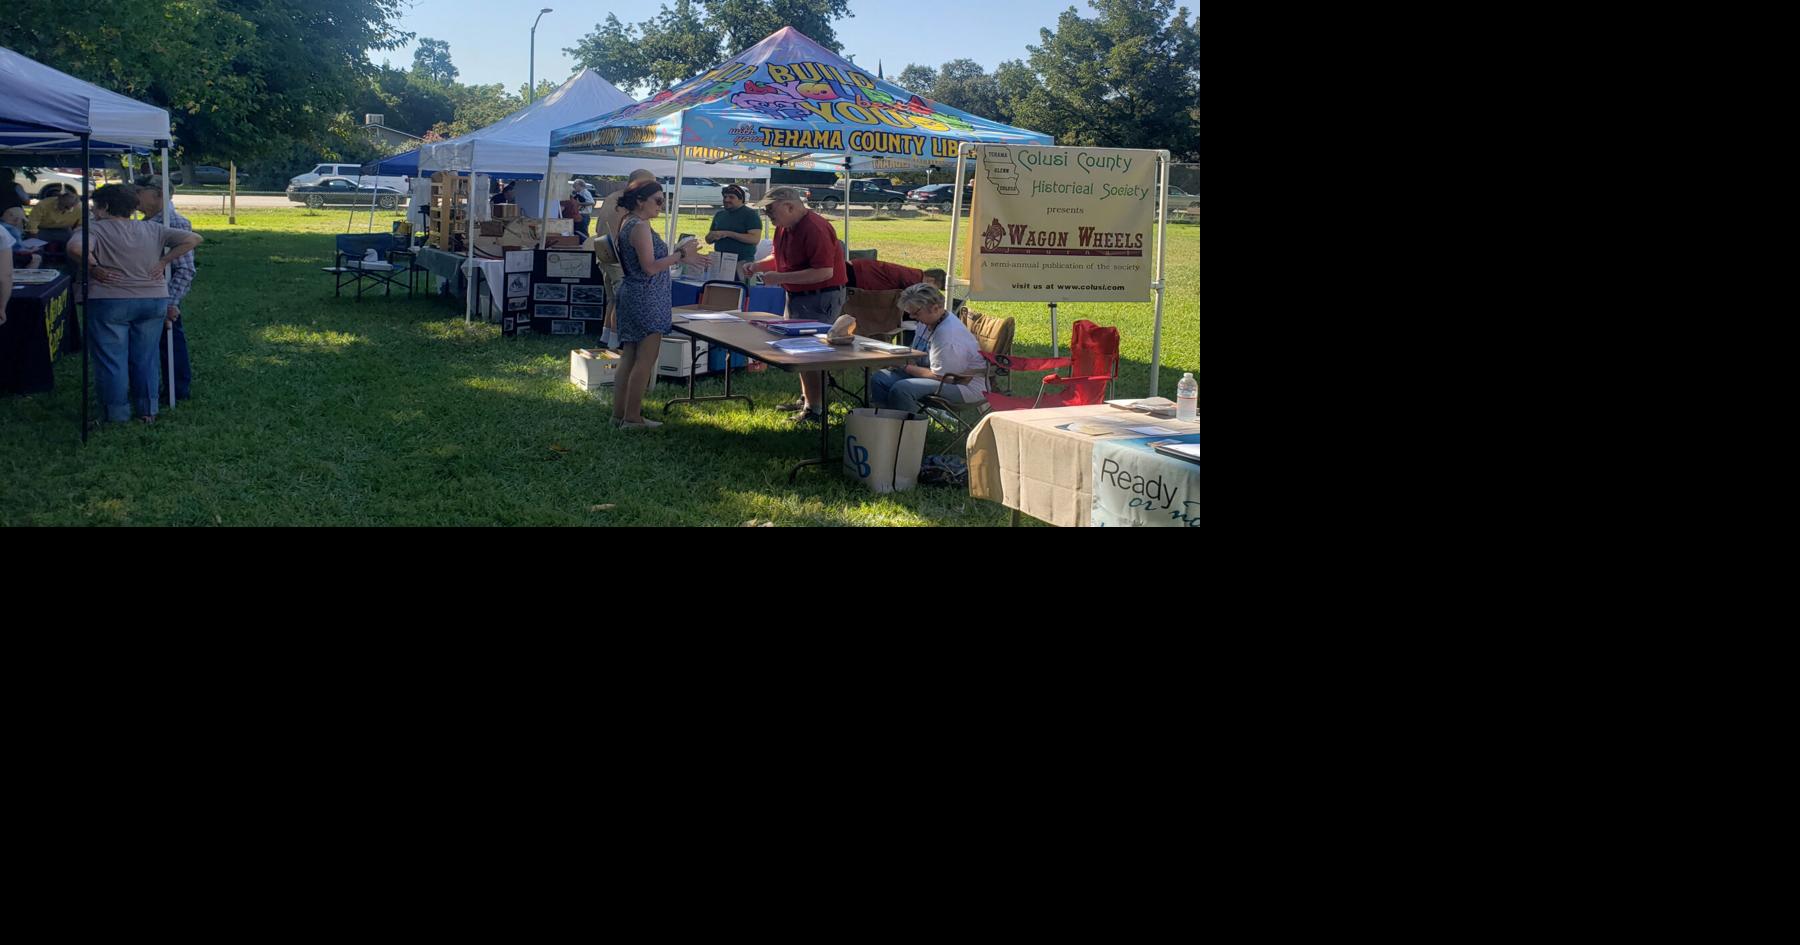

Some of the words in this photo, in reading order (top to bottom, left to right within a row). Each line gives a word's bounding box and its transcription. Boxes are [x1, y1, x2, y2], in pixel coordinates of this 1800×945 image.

[767, 61, 875, 89] BUILD
[800, 101, 916, 129] YOU
[759, 127, 844, 150] TEHAMA
[849, 131, 926, 155] COUNTY
[1017, 149, 1068, 172] Colusi
[1077, 152, 1132, 174] County
[1031, 179, 1093, 197] Historical
[1100, 182, 1149, 201] Society
[1046, 206, 1084, 215] presents
[1007, 223, 1069, 247] WAGON
[1078, 226, 1143, 249] WHEELS
[990, 261, 1040, 269] semi-annual
[1042, 262, 1084, 270] publication
[1086, 262, 1094, 270] of
[1097, 262, 1110, 270] the
[1113, 263, 1140, 272] society
[1057, 283, 1125, 291] www.colusi.com
[1101, 458, 1178, 509] Ready
